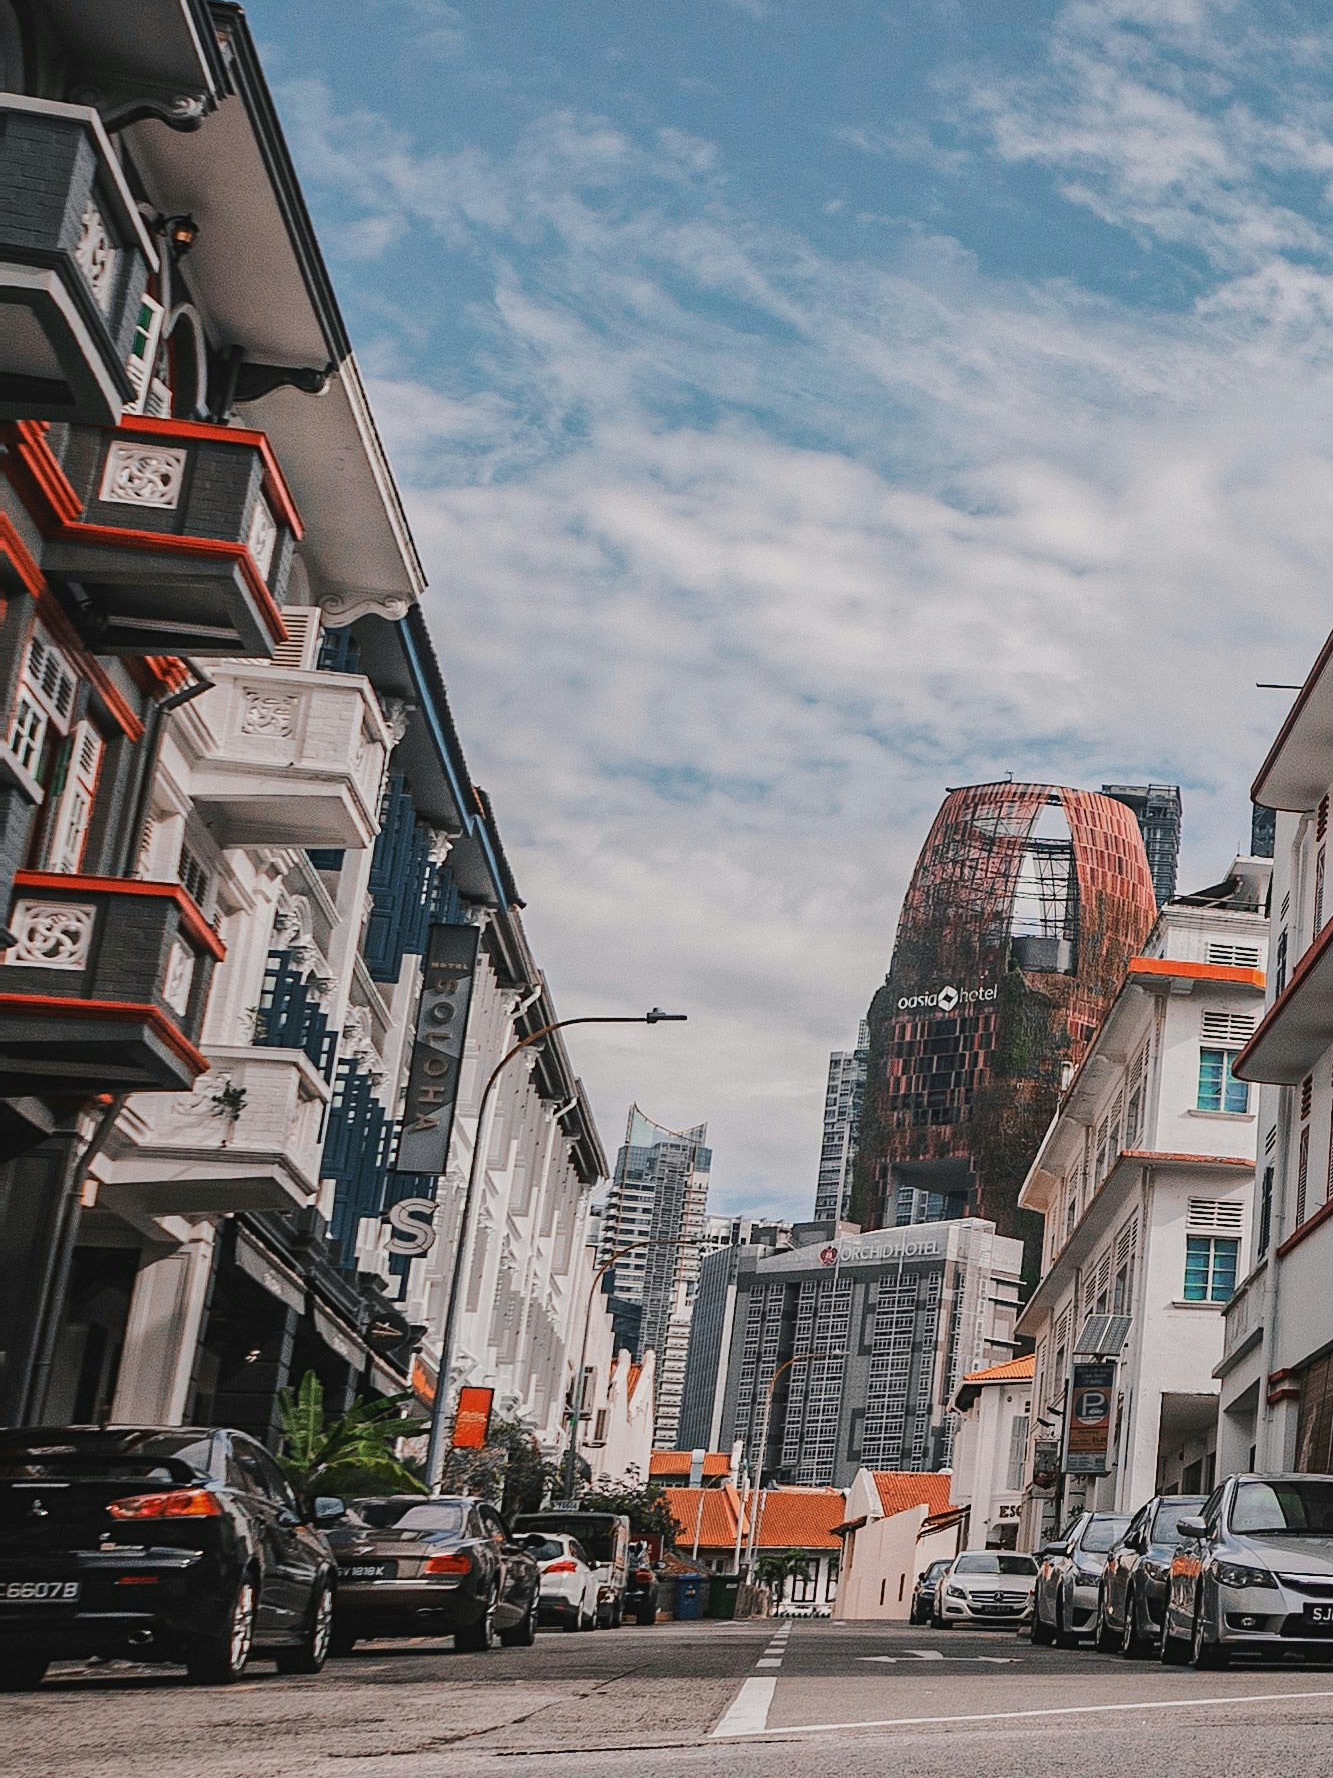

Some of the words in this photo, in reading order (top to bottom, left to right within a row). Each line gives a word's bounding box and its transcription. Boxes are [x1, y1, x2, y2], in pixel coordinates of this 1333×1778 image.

[431, 961, 469, 970] HOTEL
[898, 990, 937, 1009] oasia
[959, 984, 998, 1004] hotel
[408, 978, 459, 1135] SOLOHA
[840, 1244, 898, 1262] ORCHID
[898, 1240, 940, 1258] HOTEL
